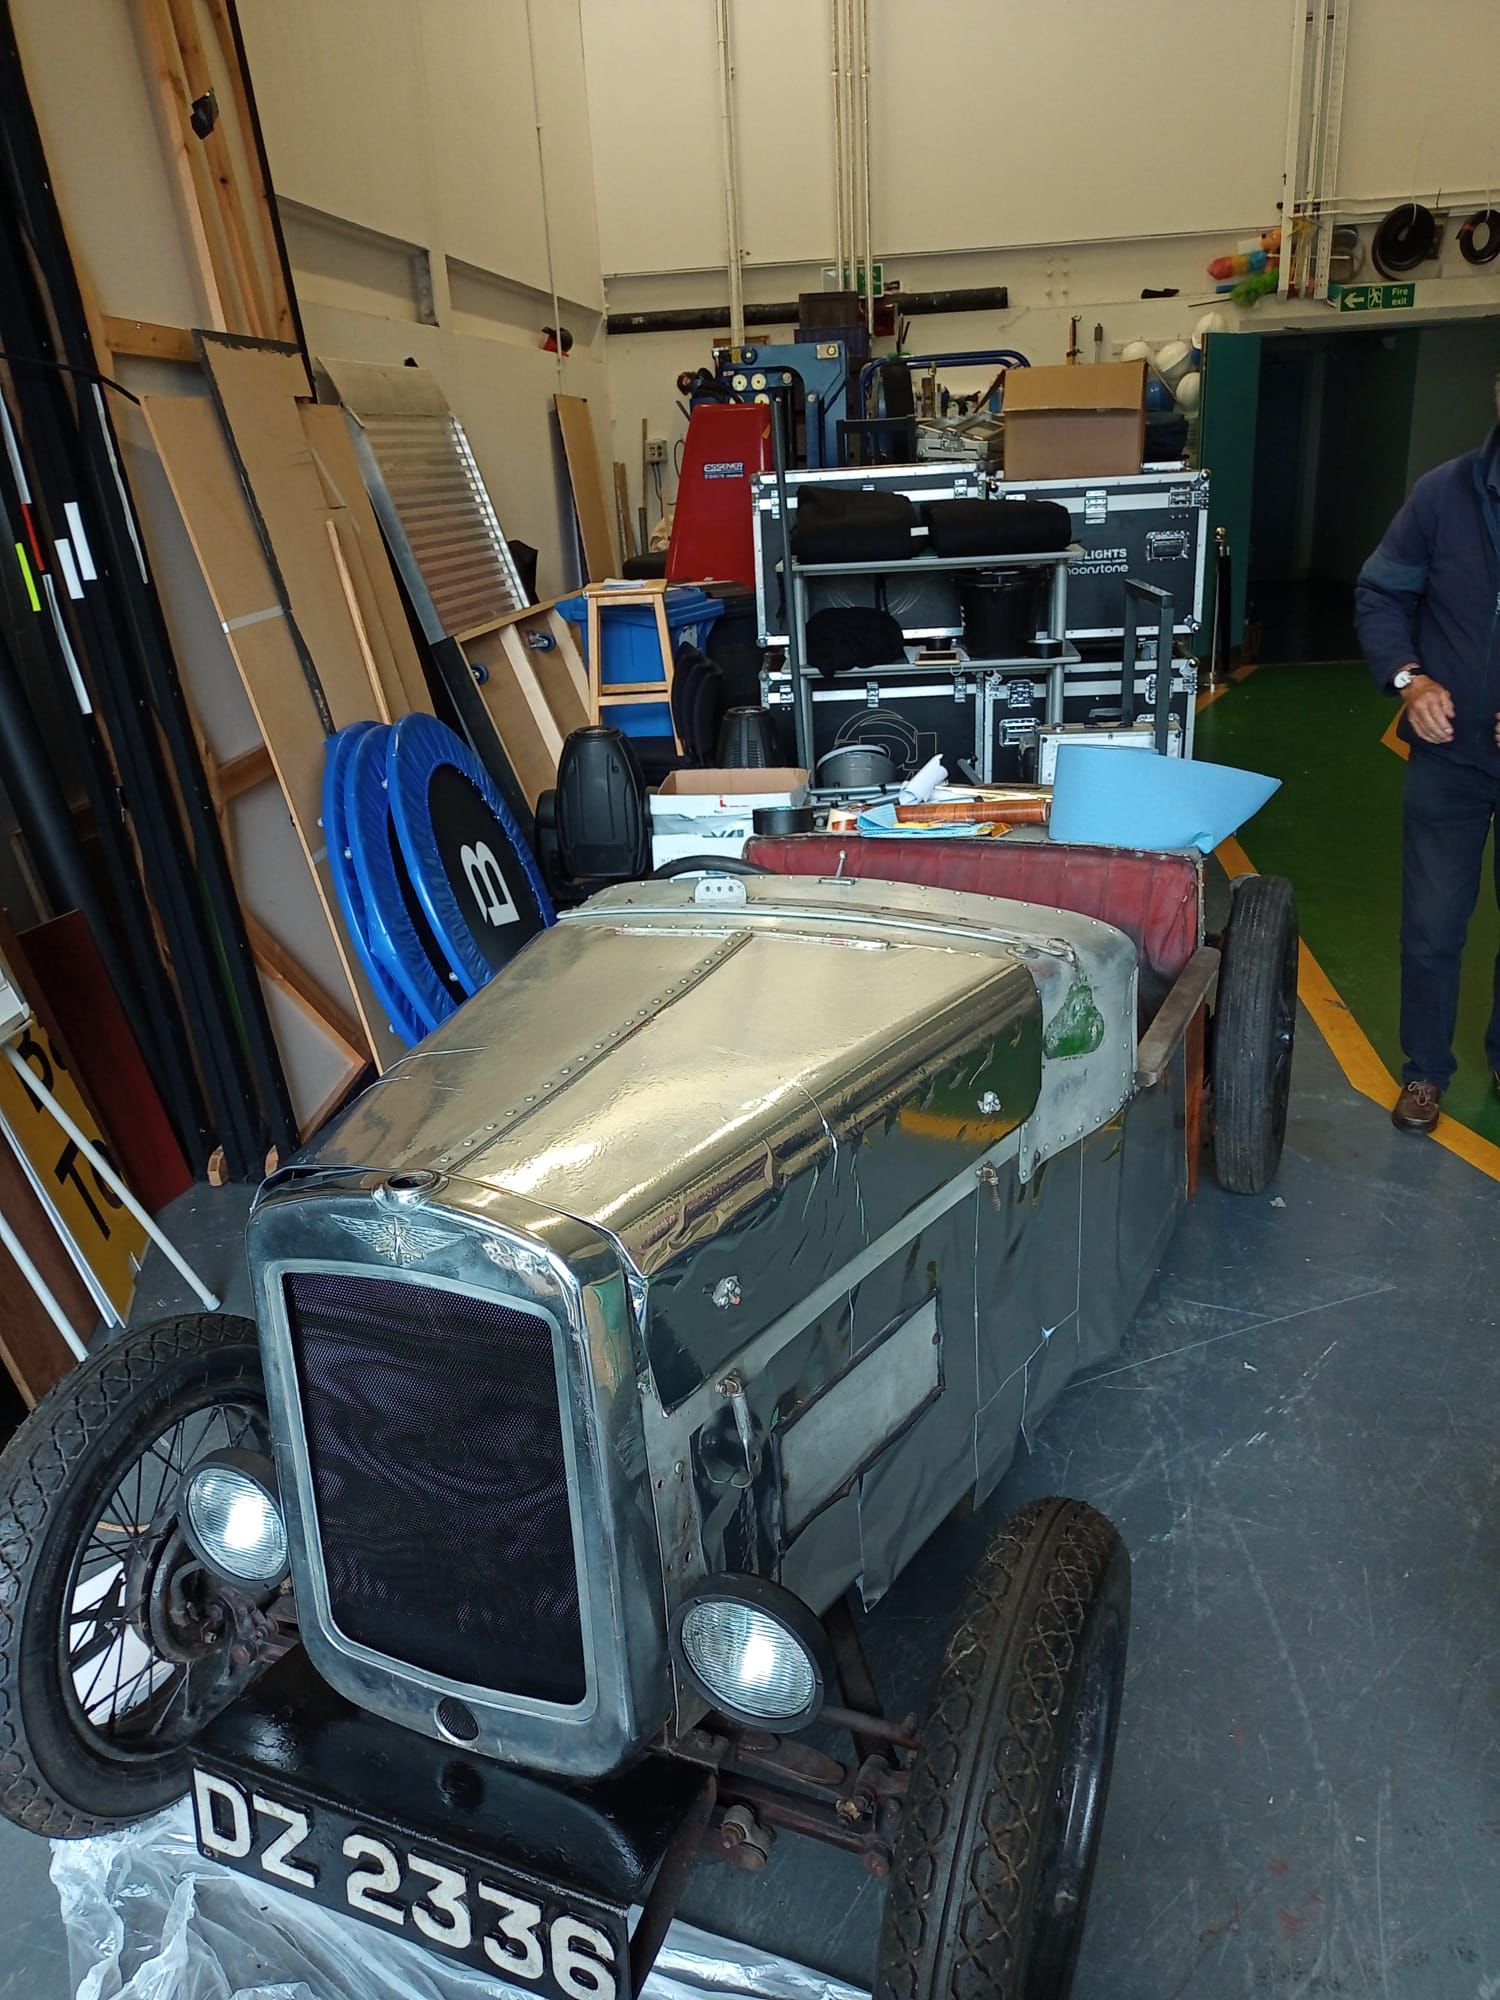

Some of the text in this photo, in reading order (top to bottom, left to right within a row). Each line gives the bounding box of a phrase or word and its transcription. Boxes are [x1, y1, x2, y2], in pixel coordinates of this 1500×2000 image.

[1391, 287, 1409, 296] Fire
[1391, 297, 1407, 306] exit
[1077, 548, 1127, 560] LIGHTS
[192, 1767, 619, 2000] DZ 2336
